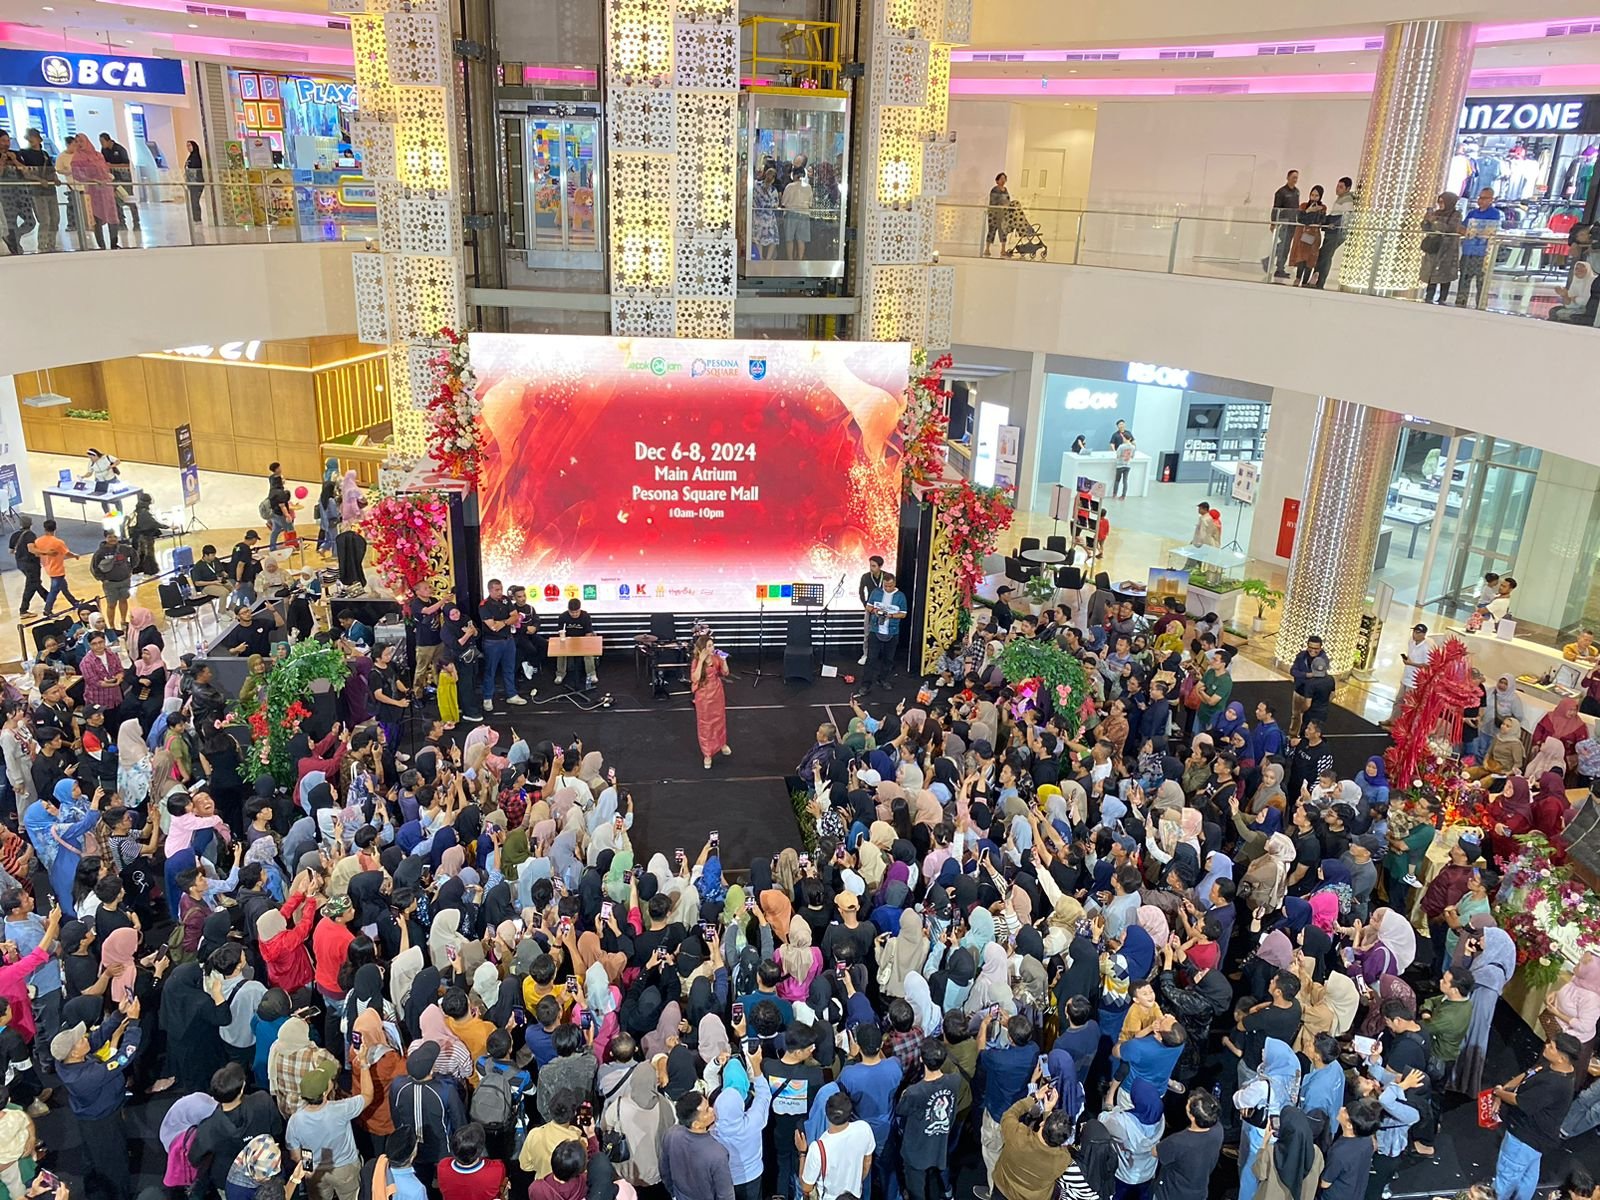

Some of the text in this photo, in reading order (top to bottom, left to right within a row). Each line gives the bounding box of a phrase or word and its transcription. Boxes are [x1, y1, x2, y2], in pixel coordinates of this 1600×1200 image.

[78, 59, 147, 88] BCA
[706, 359, 739, 368] PESONA
[706, 368, 739, 378] SQUARE
[634, 441, 757, 463] Dec 6-8, 2024
[654, 465, 737, 482] Main Atrium
[632, 485, 759, 503] Pesona Square Mall
[668, 507, 725, 520] 10am-10pm
